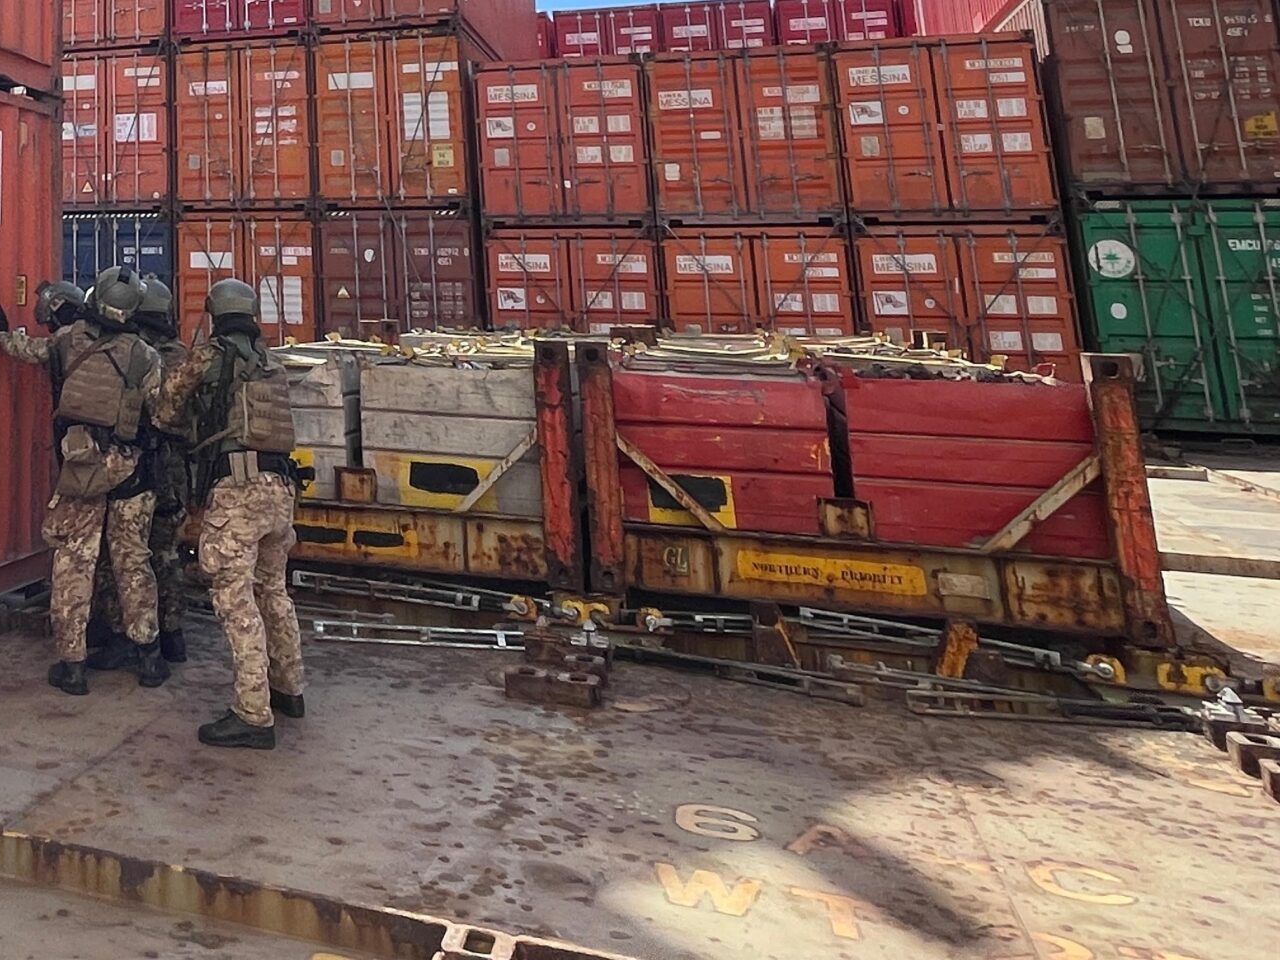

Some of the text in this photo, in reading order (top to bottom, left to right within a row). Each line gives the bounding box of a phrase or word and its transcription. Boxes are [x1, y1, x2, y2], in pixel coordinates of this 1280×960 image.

[852, 72, 908, 84] MESSINA
[489, 91, 536, 101] MESSINA
[660, 96, 711, 107] MESSNA
[1228, 239, 1261, 251] EMCU
[500, 261, 549, 271] MESSINA
[678, 263, 731, 272] MESSINA
[875, 262, 935, 272] MESSINA
[663, 546, 689, 573] GL
[840, 569, 905, 586] PRIORITY
